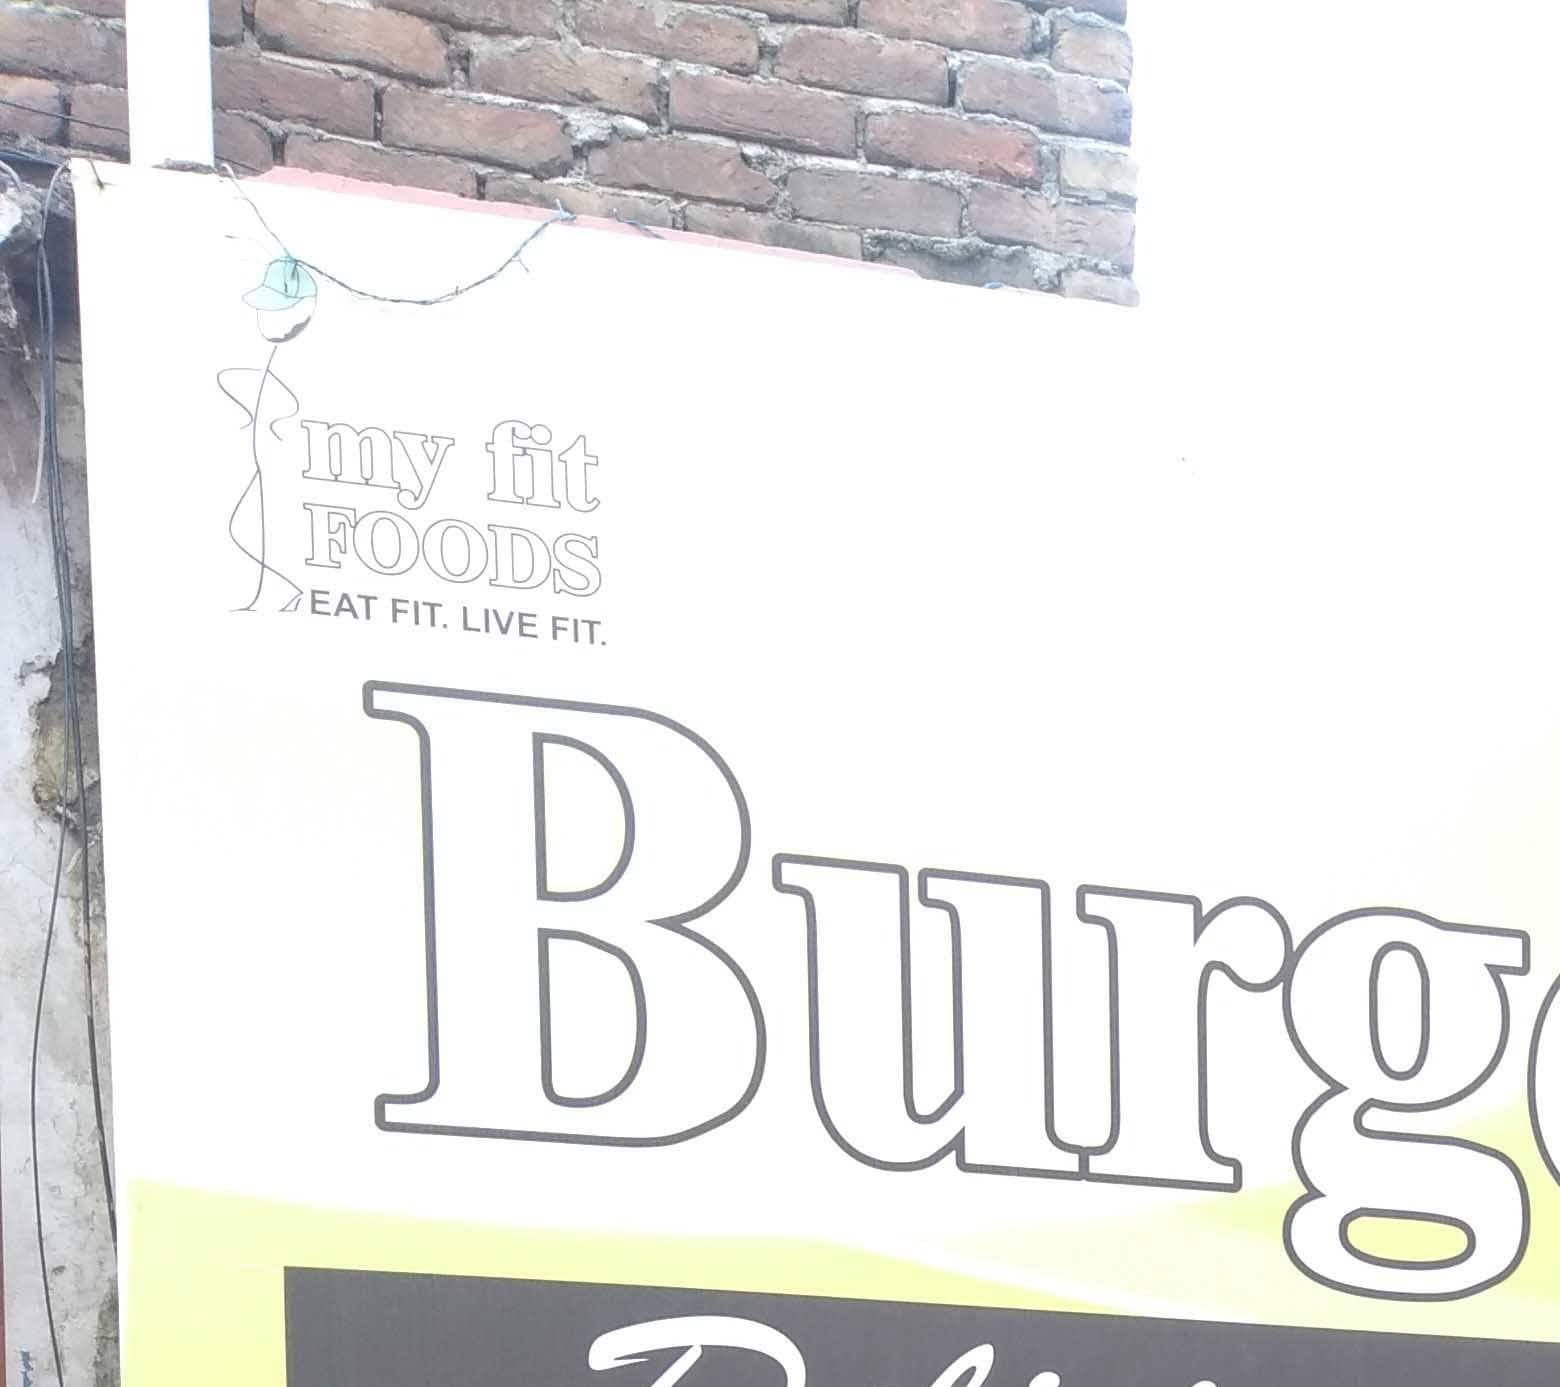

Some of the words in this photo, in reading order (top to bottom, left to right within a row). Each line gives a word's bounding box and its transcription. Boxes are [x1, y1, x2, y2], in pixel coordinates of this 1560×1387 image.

[301, 418, 454, 509] my
[485, 418, 601, 513] fit
[303, 502, 603, 598] FOODS
[309, 588, 378, 624] EAT
[390, 598, 450, 632] FIT.
[461, 605, 539, 641] LIVE
[550, 615, 608, 647] FIT.
